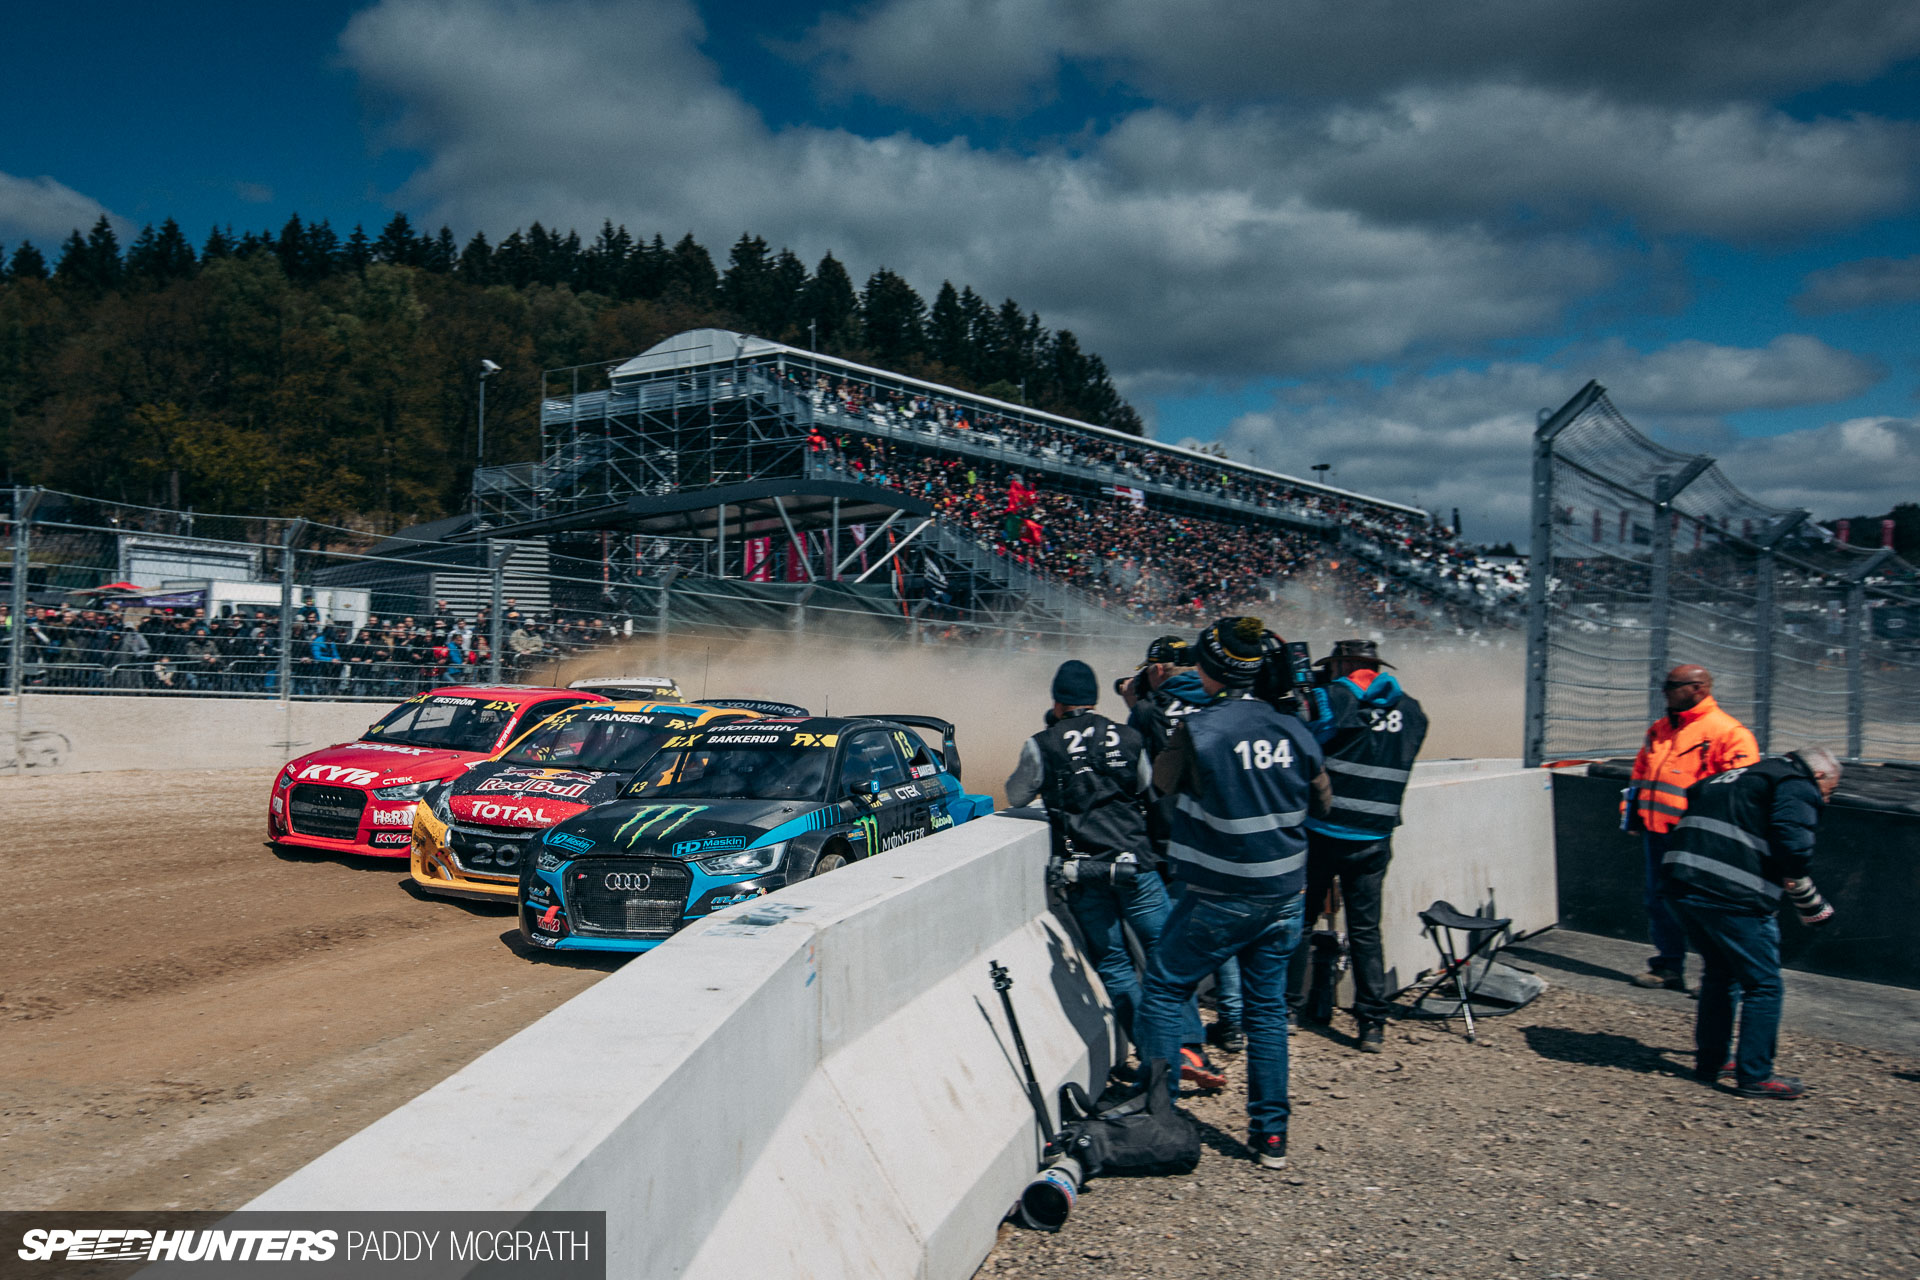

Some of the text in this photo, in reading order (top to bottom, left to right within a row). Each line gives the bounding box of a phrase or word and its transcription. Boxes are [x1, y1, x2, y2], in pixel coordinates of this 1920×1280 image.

[432, 696, 477, 706] EKSTRÖM
[587, 713, 655, 724] HANSEN
[707, 723, 799, 733] informativ
[706, 735, 780, 744] BAKKERUD
[893, 730, 915, 759] 13
[1233, 738, 1294, 770] 184
[297, 764, 379, 786] KYB
[382, 775, 413, 786] CTEK
[475, 777, 591, 798] Red Bull
[628, 781, 649, 794] 13
[894, 784, 922, 800] CTEK
[471, 800, 552, 823] TOTAL
[676, 837, 742, 855] HD Maskin
